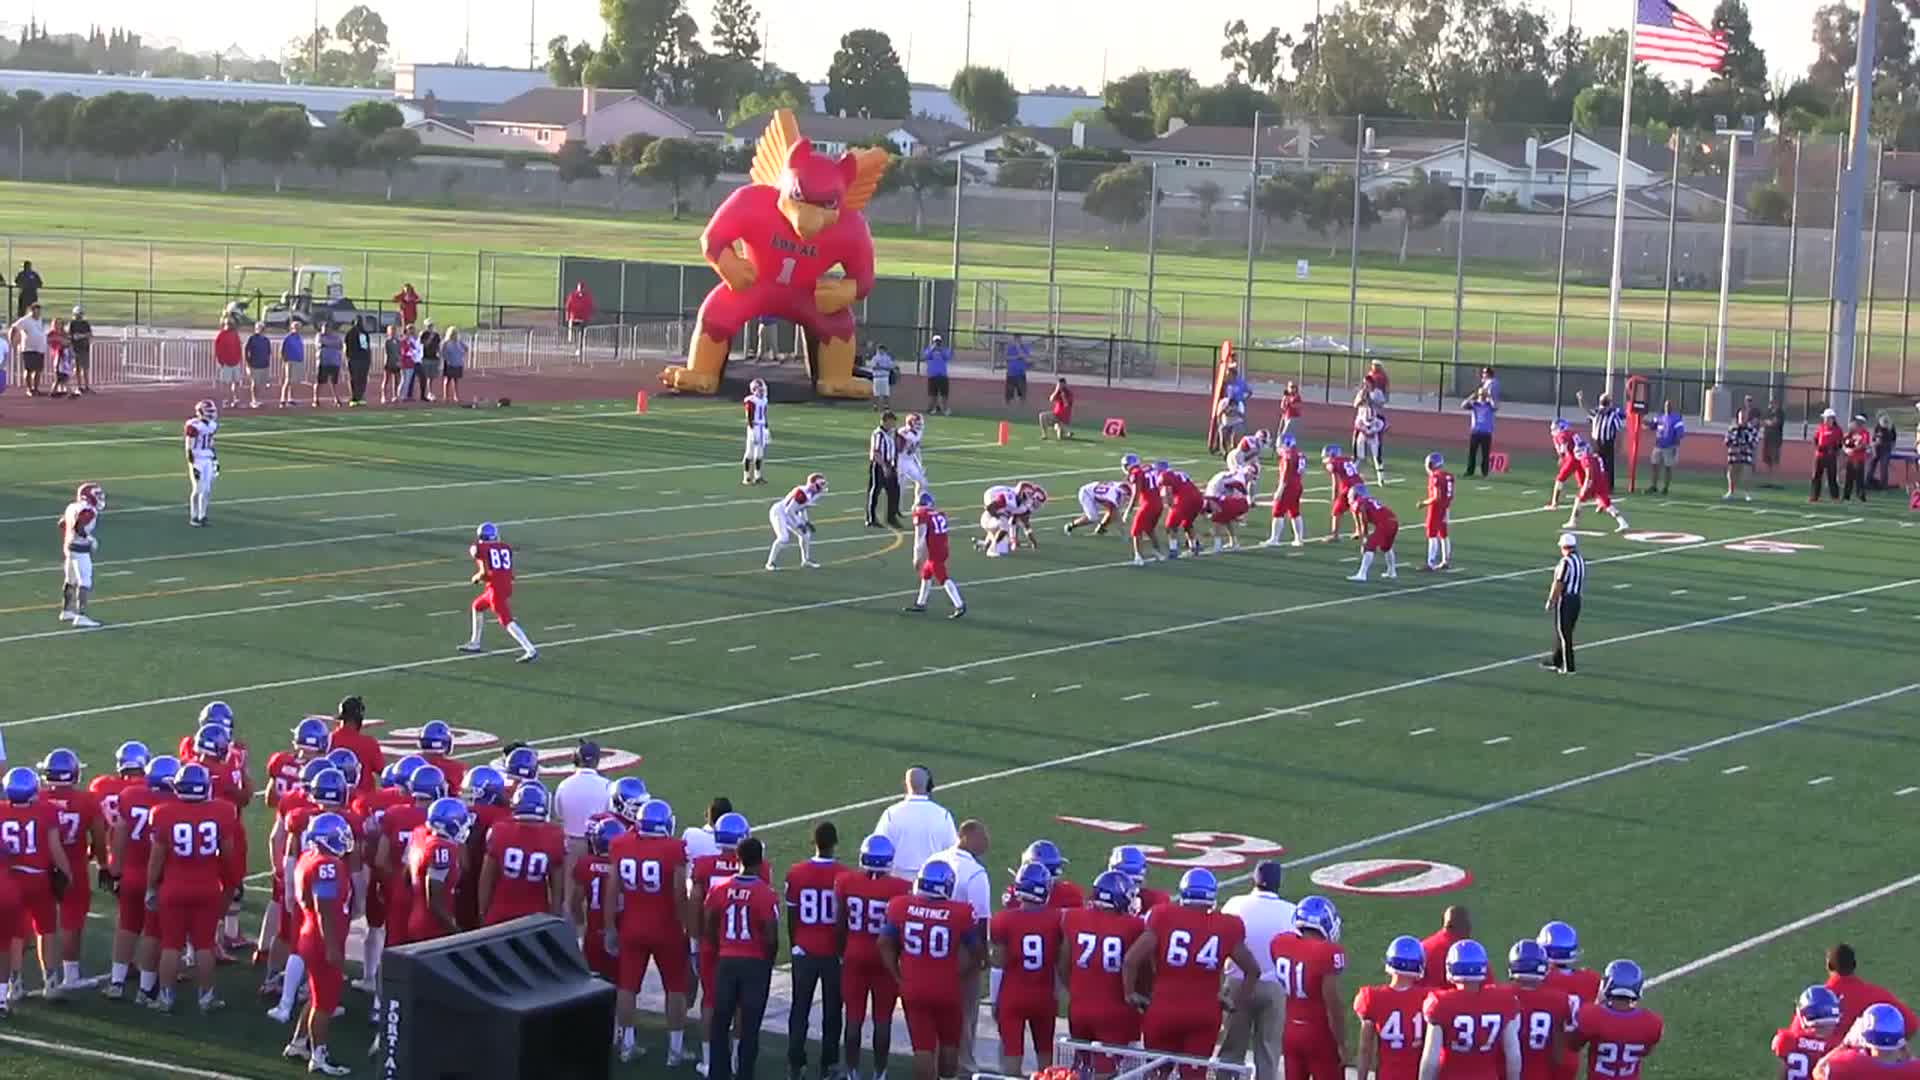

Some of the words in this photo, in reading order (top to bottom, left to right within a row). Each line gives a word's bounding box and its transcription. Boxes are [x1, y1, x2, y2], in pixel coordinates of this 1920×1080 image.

[931, 515, 947, 533] 12
[489, 548, 511, 569] 83
[1, 819, 37, 855] 61
[173, 821, 218, 856] 93
[319, 864, 335, 878] 65
[434, 848, 449, 863] 18
[504, 847, 549, 882] 90
[620, 858, 661, 893] 99
[725, 904, 751, 940] 11
[800, 889, 838, 924] 80
[847, 897, 887, 935] 35
[904, 922, 949, 958] 50
[1023, 935, 1043, 970] 9
[1076, 933, 1122, 972] 78
[1167, 930, 1219, 969] 64
[1276, 957, 1308, 999] 91
[1380, 1011, 1423, 1048] 41
[1452, 1014, 1501, 1051] 37
[1530, 1012, 1551, 1049] 8
[1595, 1043, 1644, 1077] 25
